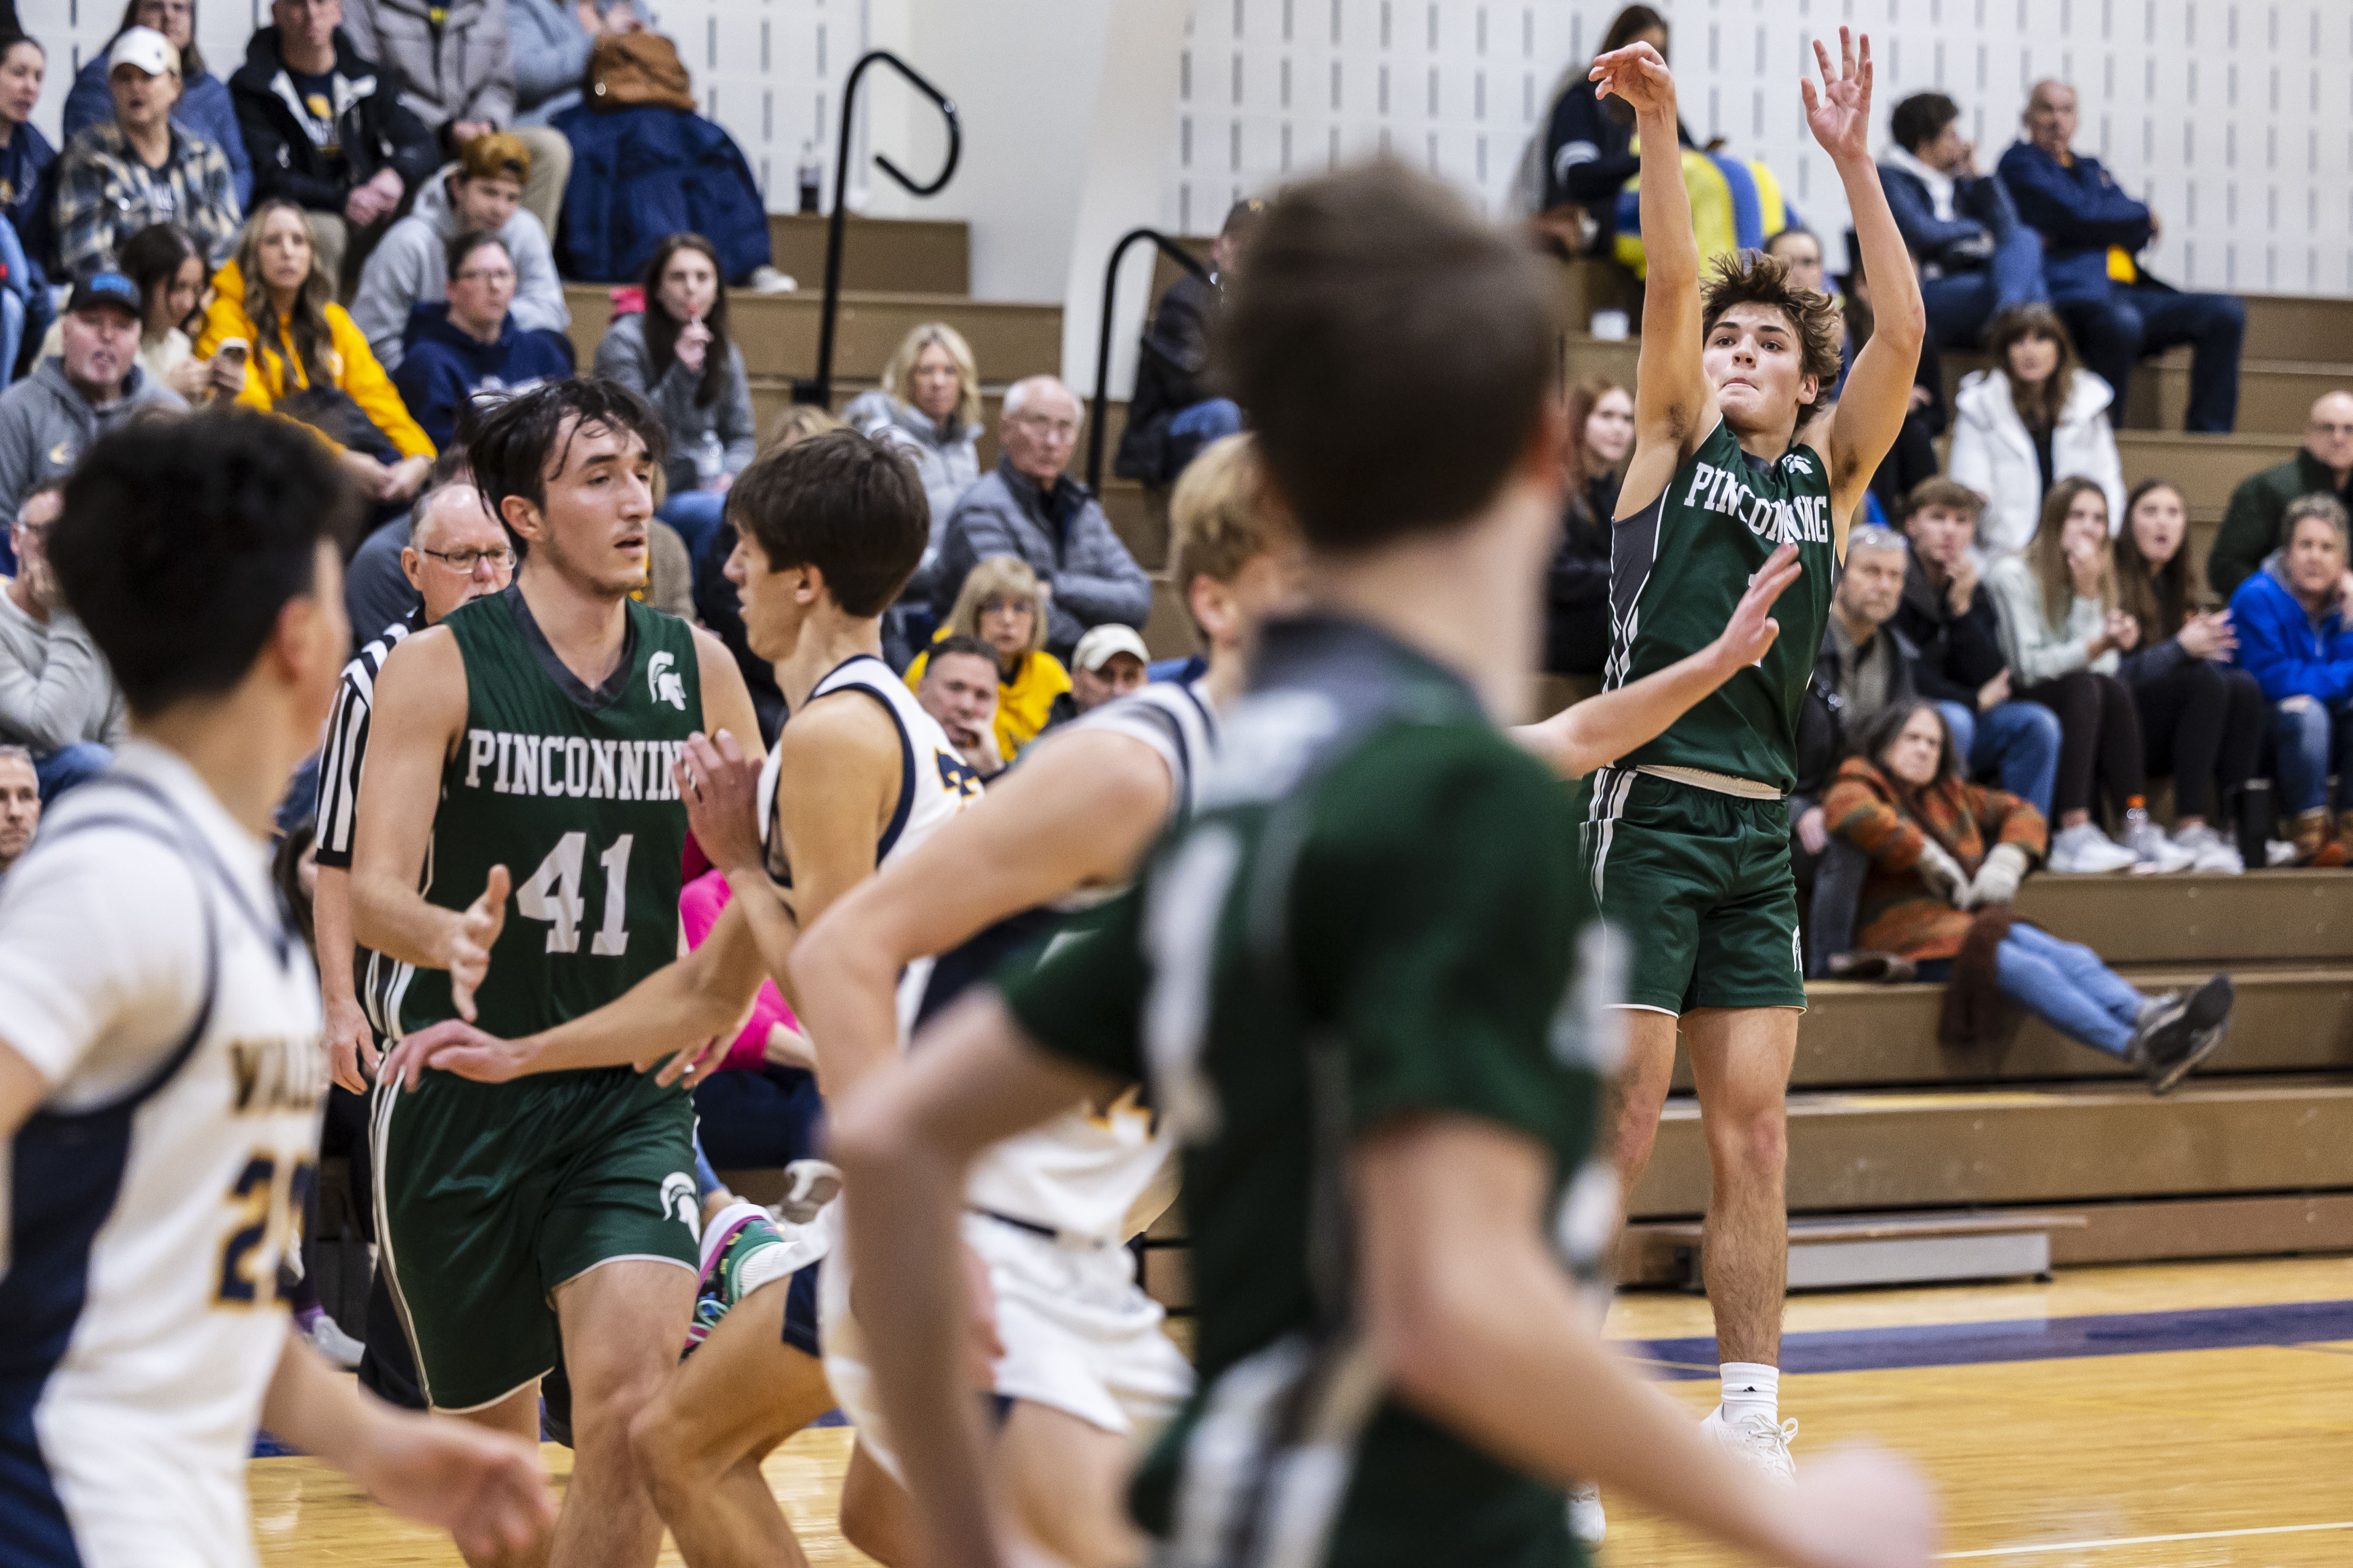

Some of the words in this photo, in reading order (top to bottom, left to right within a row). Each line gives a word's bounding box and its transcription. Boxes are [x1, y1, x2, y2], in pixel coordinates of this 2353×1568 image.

[1683, 462, 1828, 544] PINCONNING
[465, 729, 688, 801] PINCONNIN
[516, 832, 634, 956] 41
